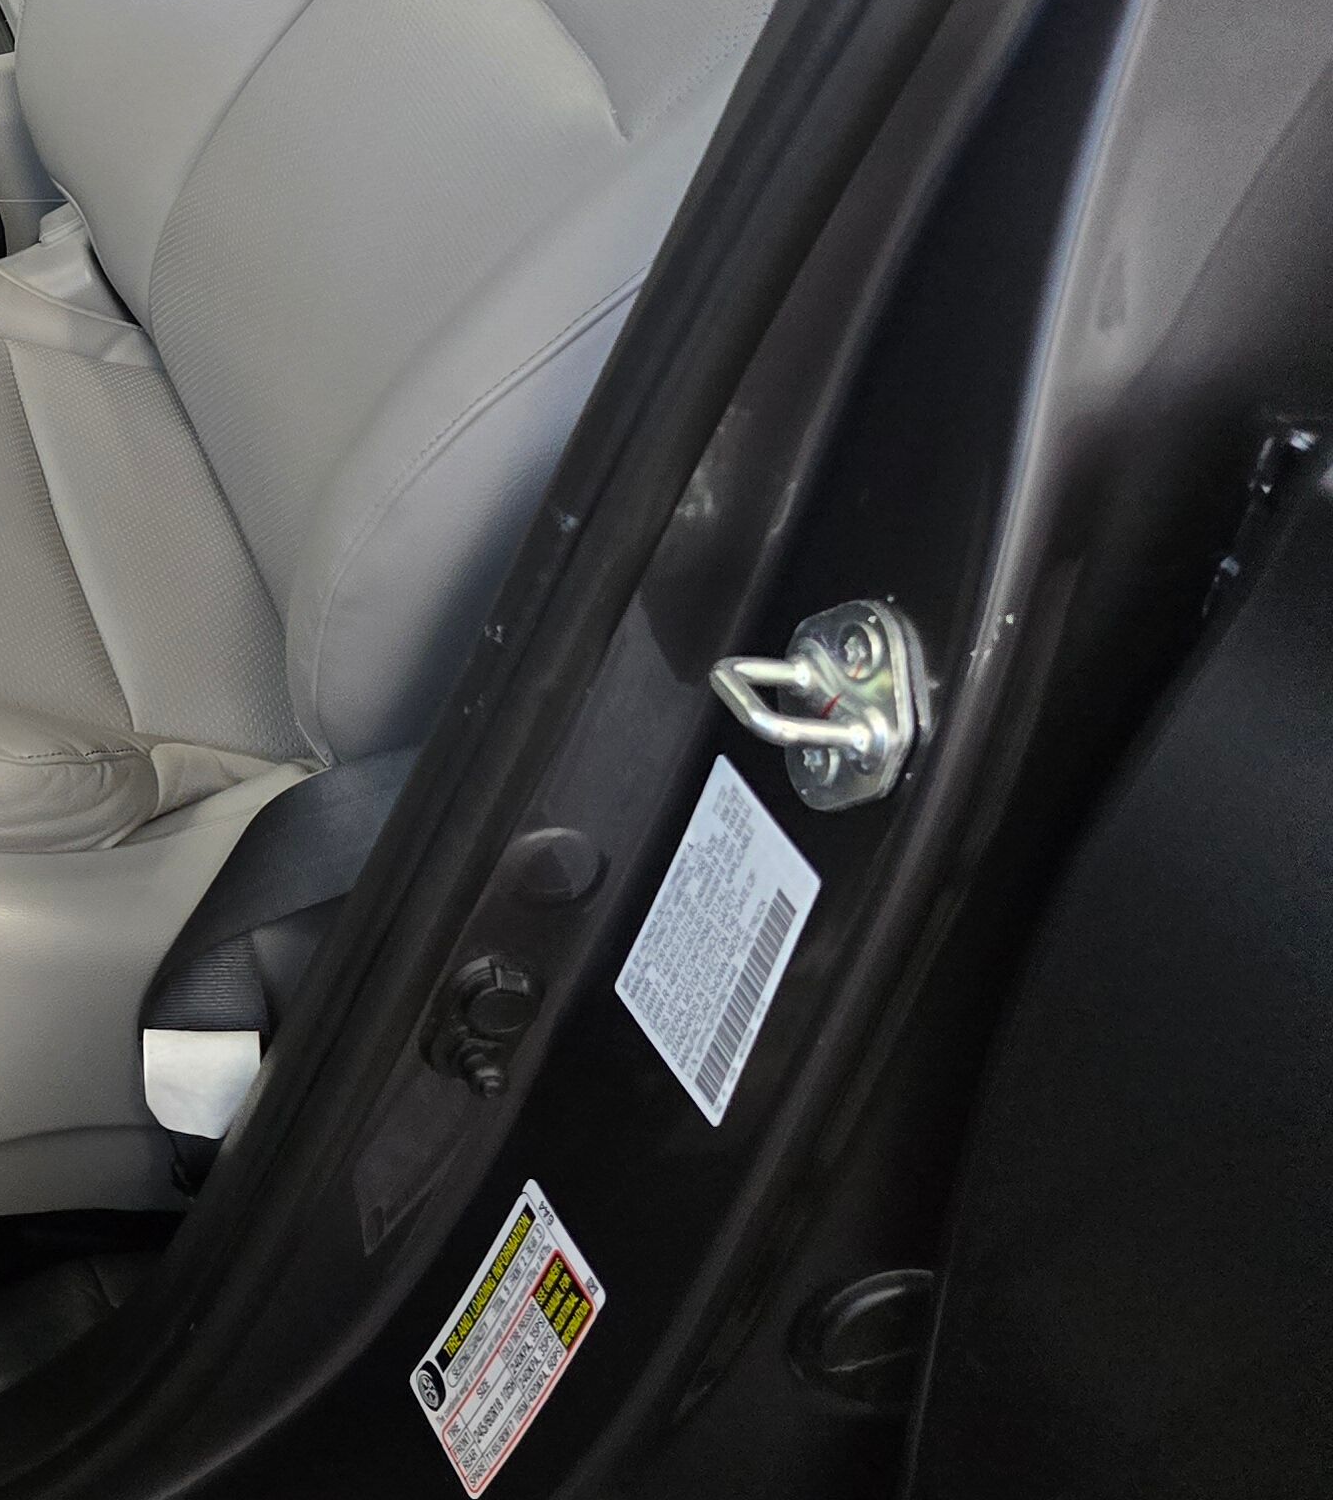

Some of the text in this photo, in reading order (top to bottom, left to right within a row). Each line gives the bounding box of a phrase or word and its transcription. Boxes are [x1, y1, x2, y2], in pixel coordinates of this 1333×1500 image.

[442, 1210, 533, 1361] TIRE AND LOADING INFORMATION
[557, 1271, 572, 1293] FOR
[475, 1376, 490, 1401] SIZE
[461, 1444, 478, 1473] REAR
